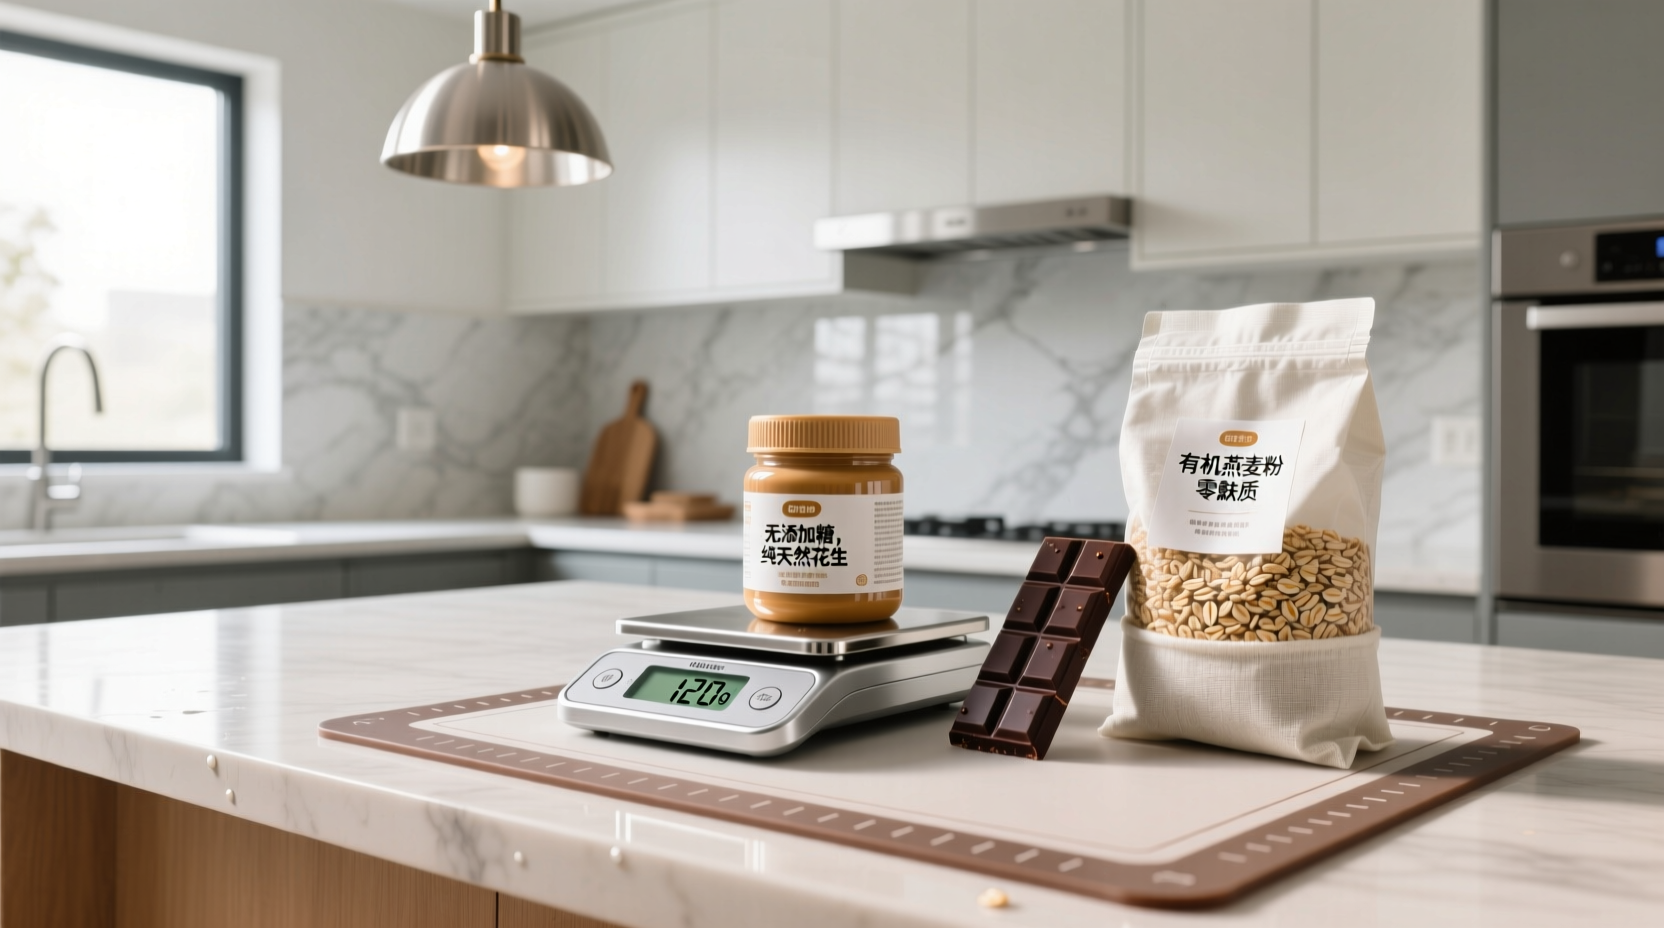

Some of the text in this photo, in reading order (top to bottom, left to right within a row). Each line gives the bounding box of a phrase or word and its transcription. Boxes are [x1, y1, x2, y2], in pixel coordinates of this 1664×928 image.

[1178, 452, 1284, 477] 有机燕麦粉
[760, 545, 848, 567] 纯天然花生
